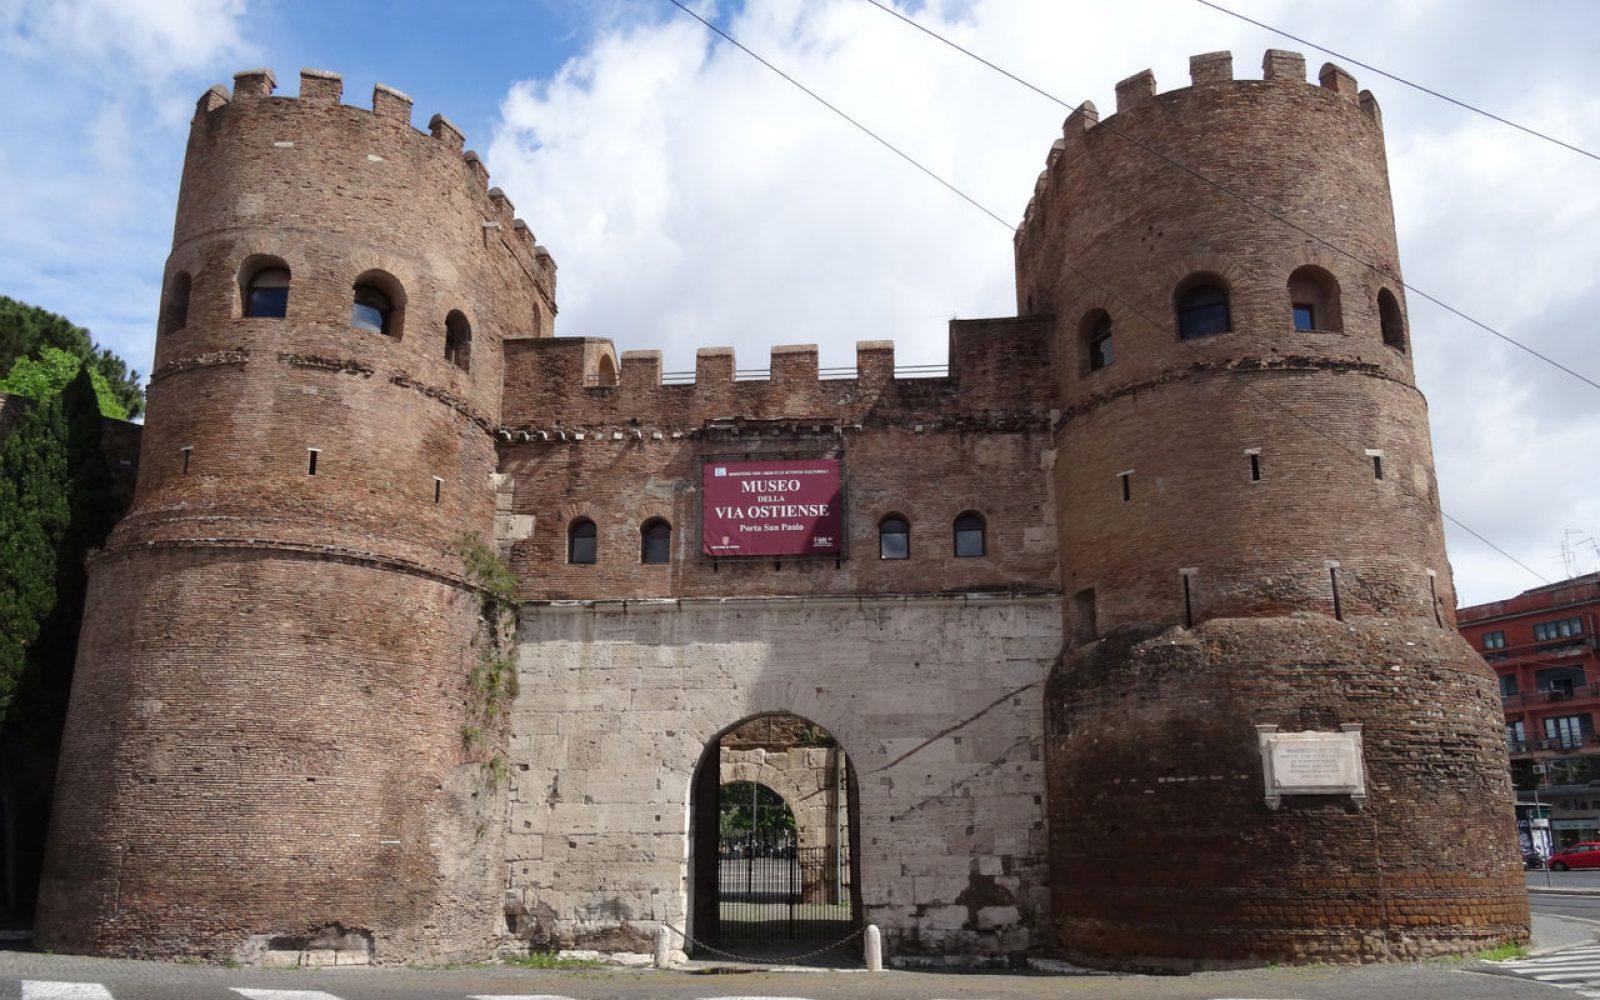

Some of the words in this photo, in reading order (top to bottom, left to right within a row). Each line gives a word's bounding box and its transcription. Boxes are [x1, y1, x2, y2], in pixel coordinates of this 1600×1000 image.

[741, 479, 801, 493] MUSEO
[758, 495, 785, 503] DELLA
[715, 506, 745, 519] VIA
[747, 504, 830, 519] OSTIENSE
[739, 524, 762, 533] Porta
[763, 523, 779, 532] San
[781, 522, 804, 531] Paolo
